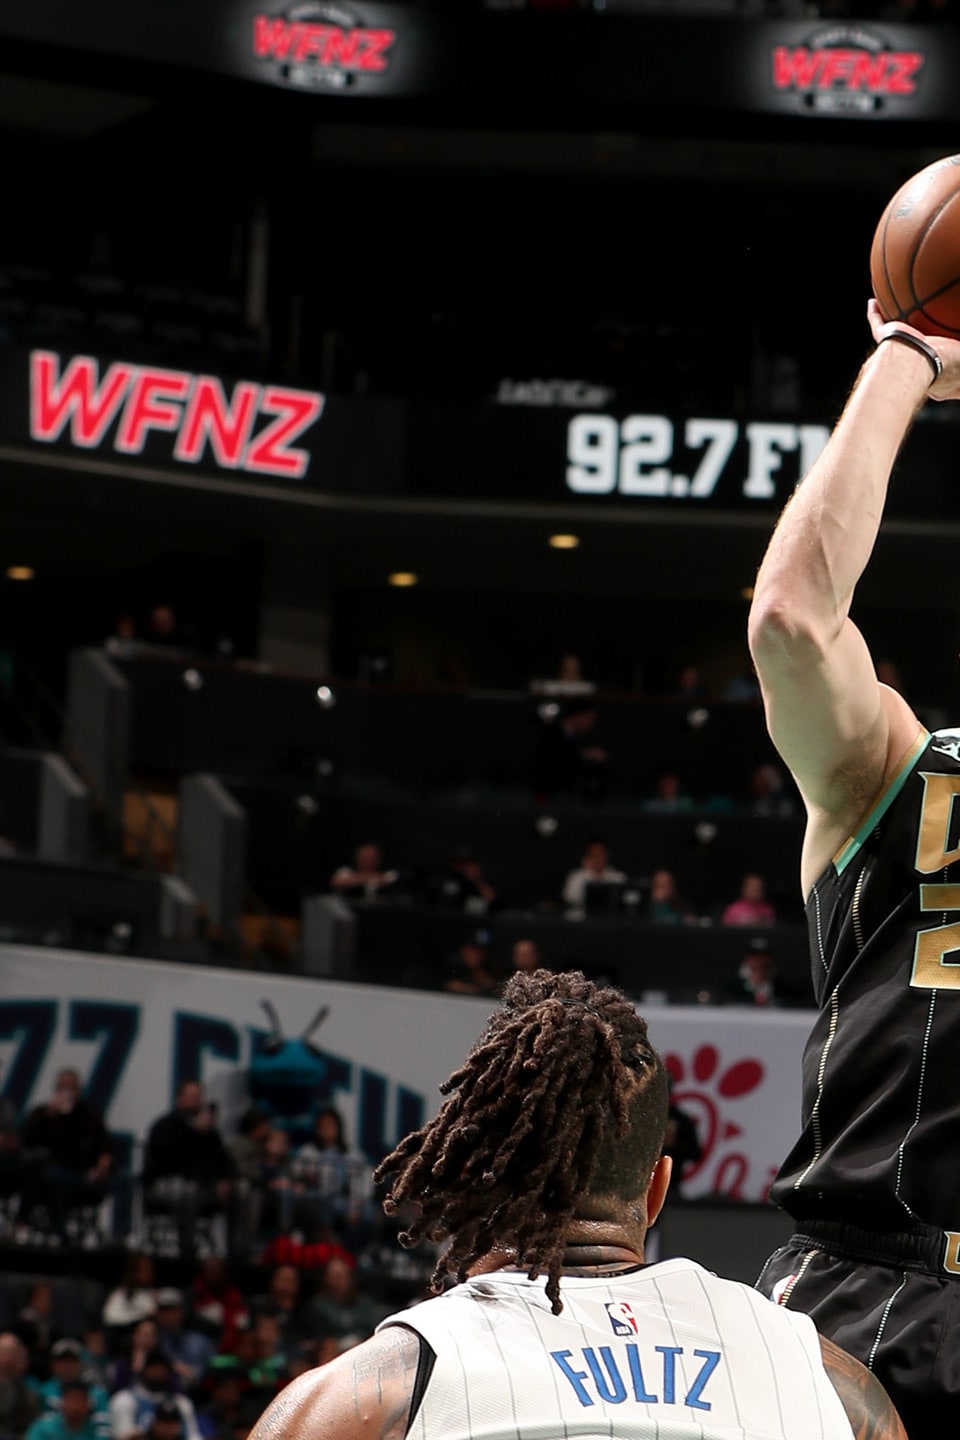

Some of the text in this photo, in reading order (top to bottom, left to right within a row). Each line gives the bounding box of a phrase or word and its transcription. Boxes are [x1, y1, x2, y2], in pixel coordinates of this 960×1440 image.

[254, 14, 394, 71] WFNZ
[773, 46, 922, 94] WFNZ
[30, 349, 325, 478] WFNZ
[566, 414, 738, 498] 92.7
[550, 1343, 722, 1411] FULTZ
